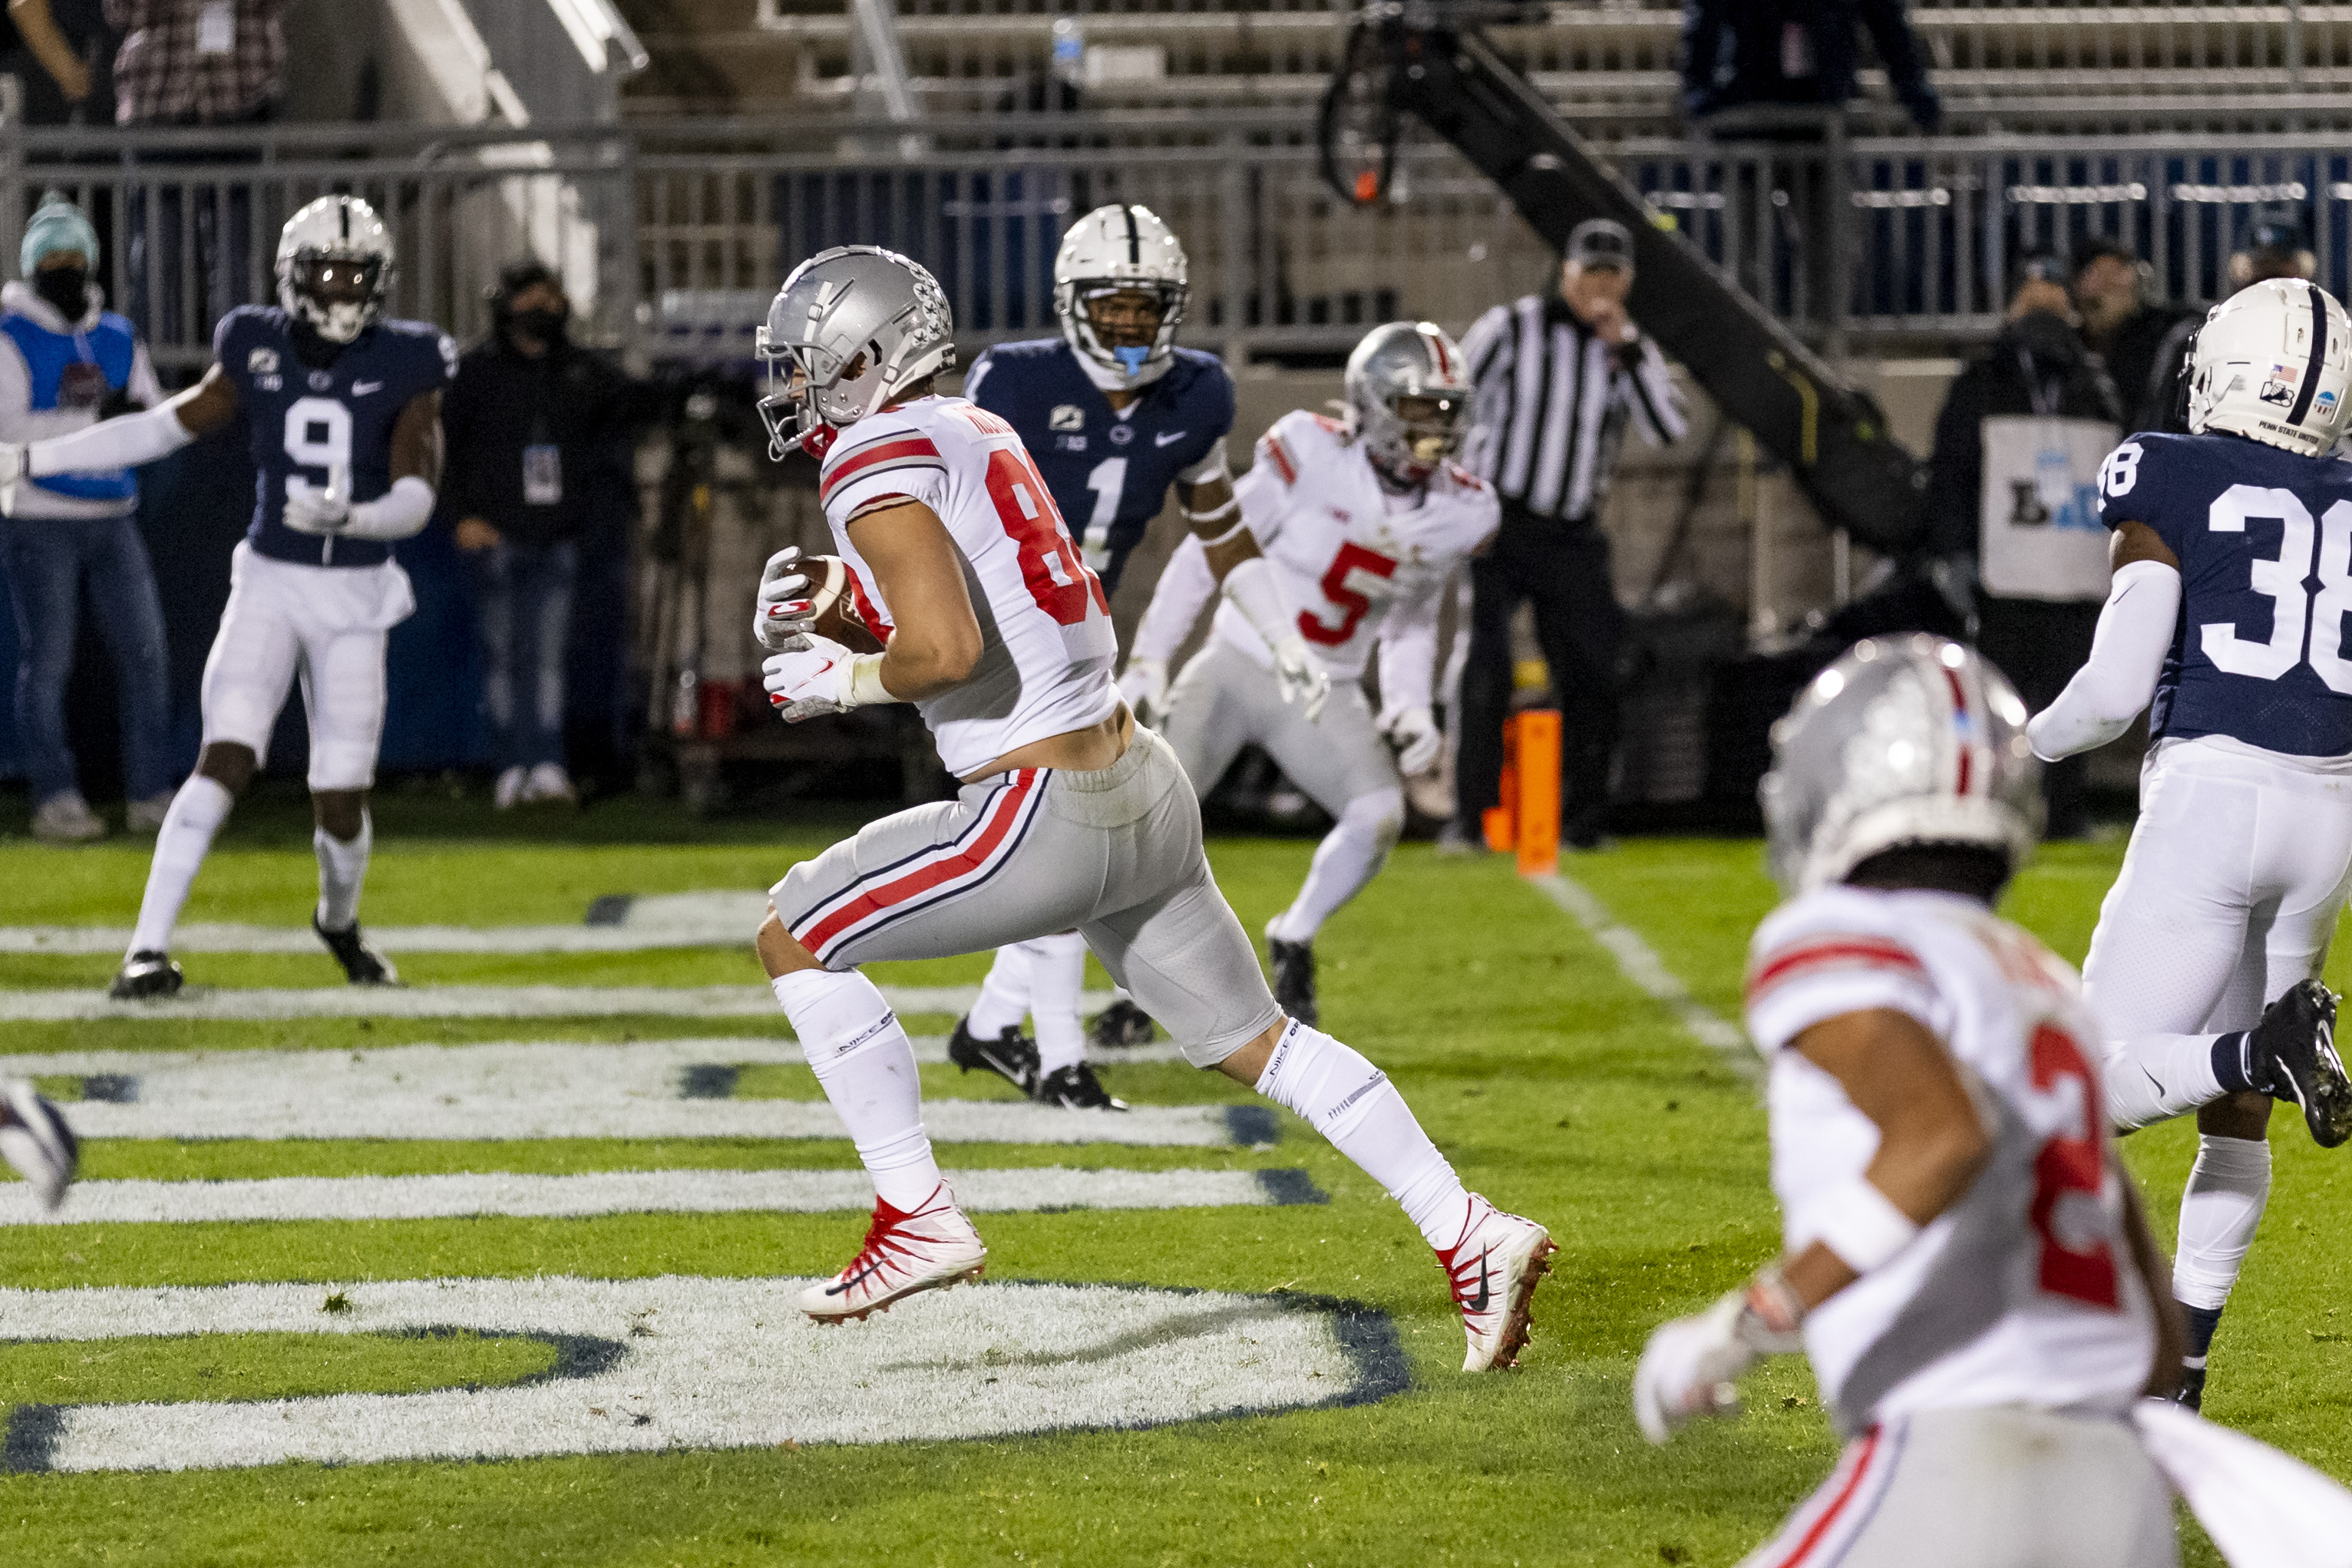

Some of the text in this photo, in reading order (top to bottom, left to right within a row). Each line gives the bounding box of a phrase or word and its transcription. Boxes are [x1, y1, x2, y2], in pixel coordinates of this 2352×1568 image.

[284, 396, 353, 500] 9
[2259, 421, 2278, 431] PENN
[2278, 426, 2297, 437] STATE
[985, 448, 1111, 626] 8
[1080, 457, 1128, 573] 1
[1296, 540, 1399, 647] 5
[1269, 1038, 1290, 1075] NIKE
[2030, 1021, 2122, 1312] 2
